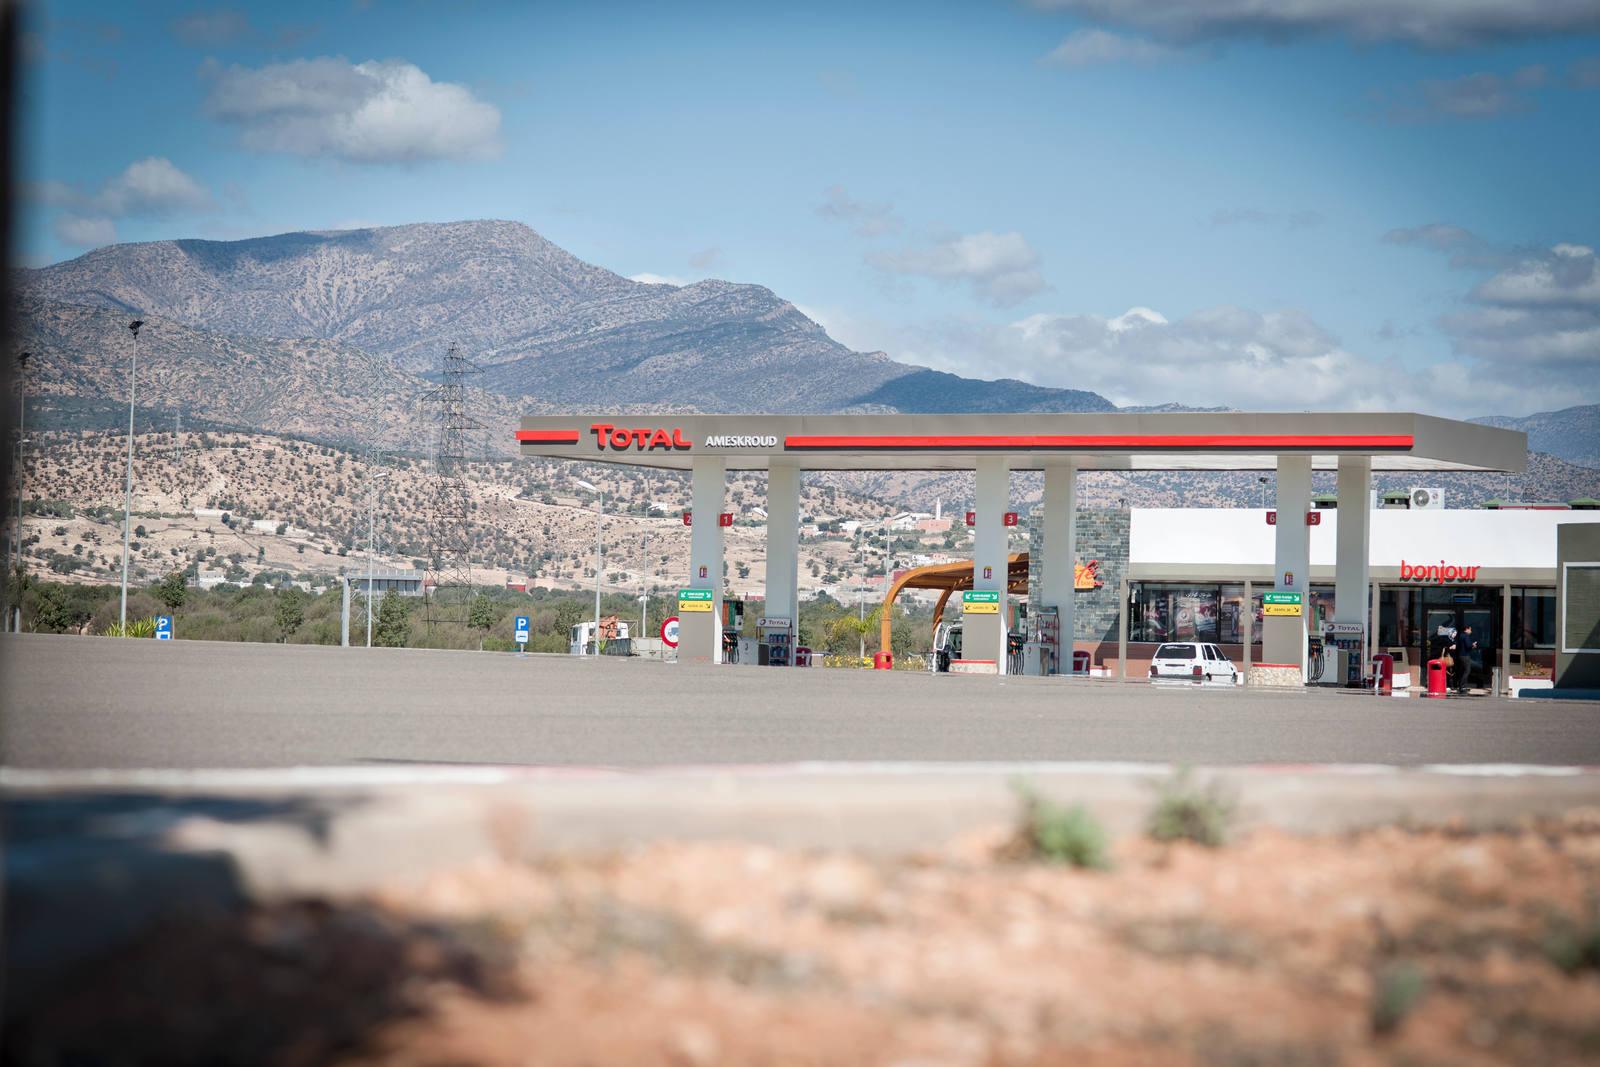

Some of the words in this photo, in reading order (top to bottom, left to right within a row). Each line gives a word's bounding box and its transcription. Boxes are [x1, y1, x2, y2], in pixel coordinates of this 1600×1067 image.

[591, 424, 692, 449] TOTAL
[705, 436, 778, 447] AMESKROUD
[1008, 515, 1013, 523] 3
[1269, 513, 1275, 523] 6
[1311, 514, 1317, 523] 5
[1401, 560, 1481, 585] bonjour
[159, 618, 168, 630] P
[518, 618, 526, 630] P
